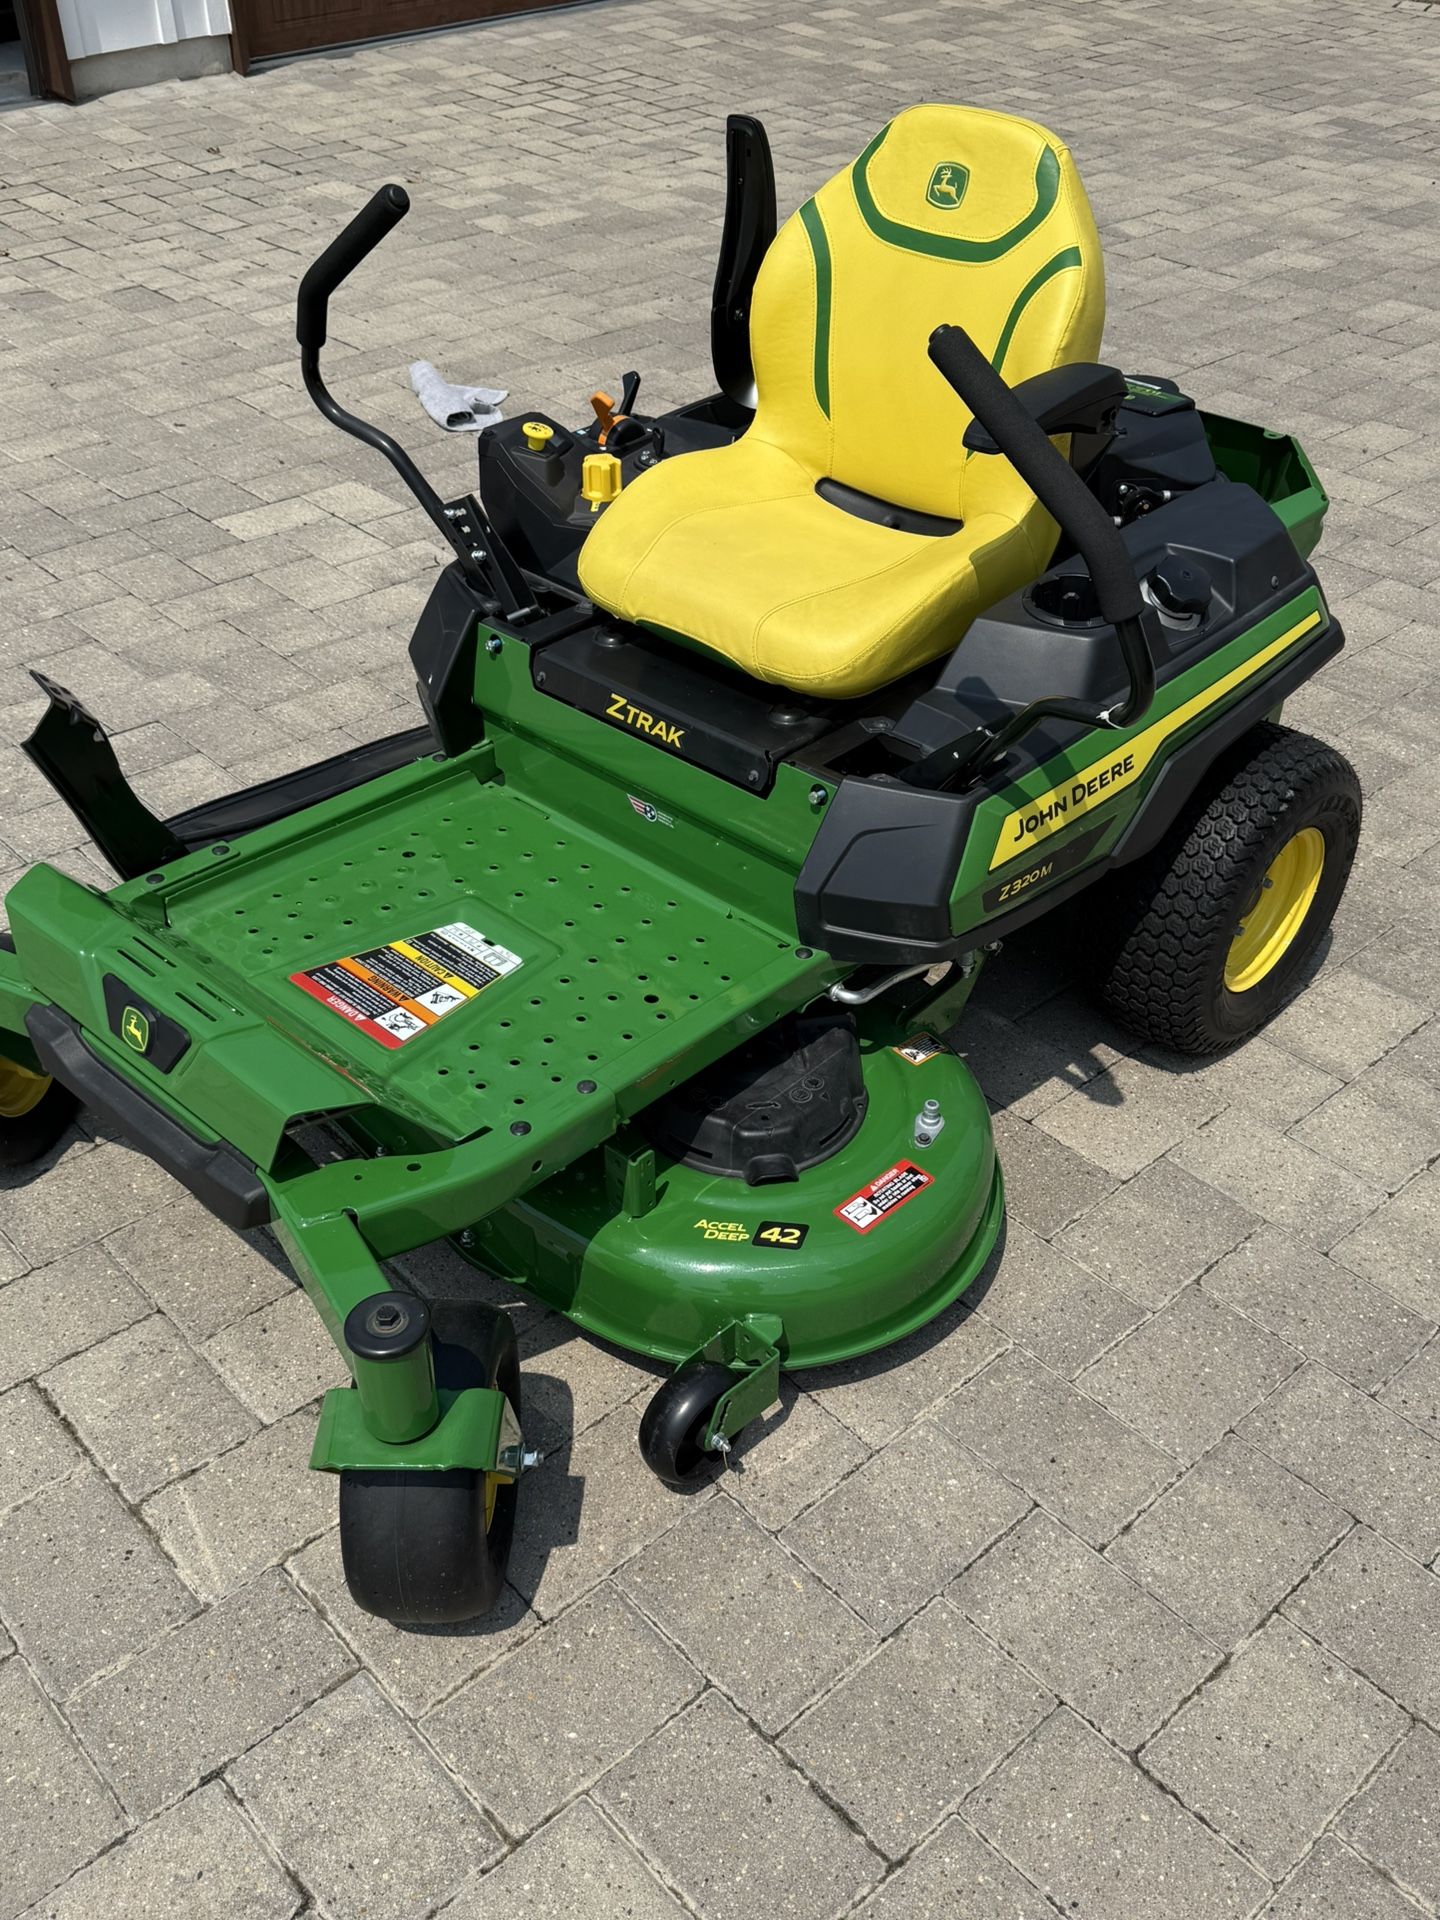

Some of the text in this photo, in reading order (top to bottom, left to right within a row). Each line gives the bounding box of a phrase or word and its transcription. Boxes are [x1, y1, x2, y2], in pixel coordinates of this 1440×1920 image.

[606, 693, 686, 749] ZTRAK
[1013, 753, 1135, 842] JOHN DEERE
[998, 862, 1054, 902] Z320M
[414, 954, 445, 976] CAUTION
[367, 974, 401, 998] WARNING
[326, 995, 358, 1018] DANGER
[875, 1168, 899, 1187] DANGER
[693, 1219, 747, 1232] ACCEL
[703, 1230, 750, 1242] DEEP
[760, 1226, 802, 1244] 42
